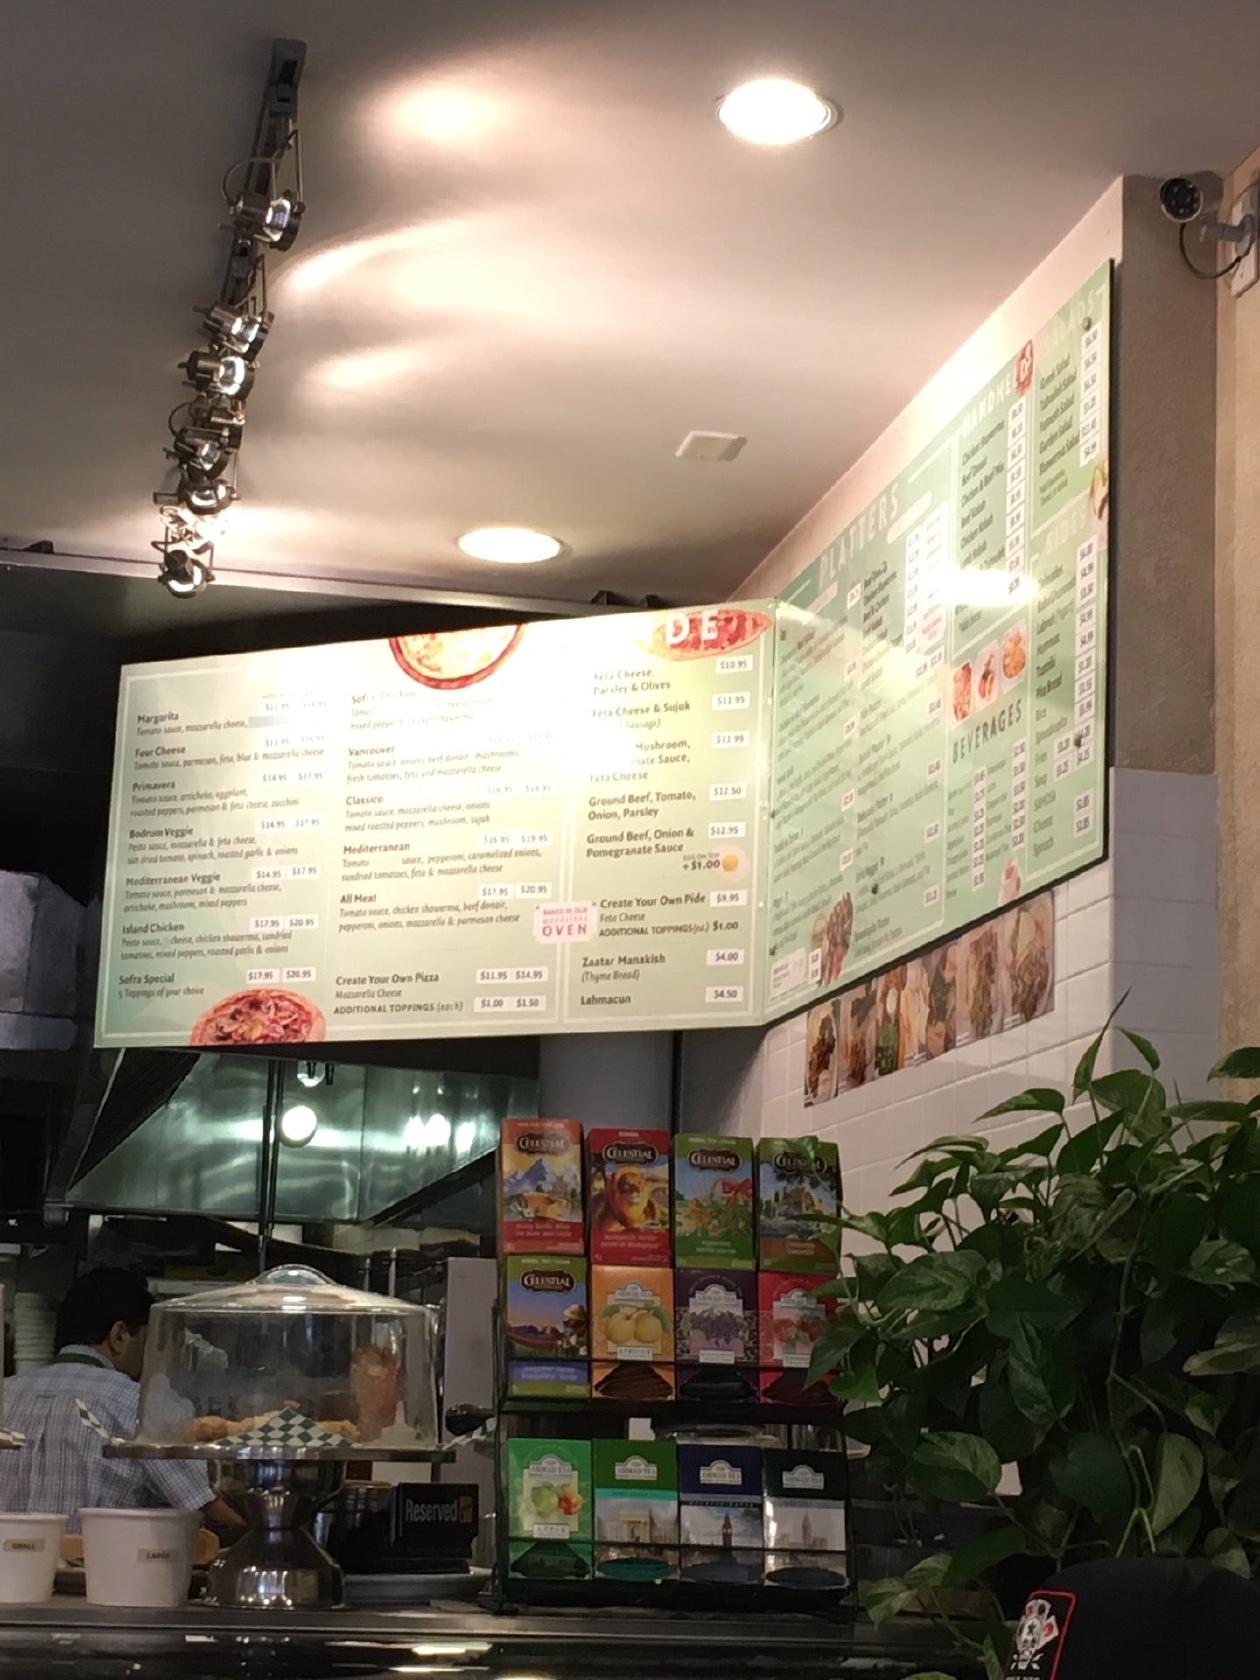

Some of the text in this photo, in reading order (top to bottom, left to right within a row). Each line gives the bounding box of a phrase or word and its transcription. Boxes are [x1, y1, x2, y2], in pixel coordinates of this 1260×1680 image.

[631, 680, 671, 692] & Olives
[653, 703, 660, 713] &
[663, 702, 690, 713] Sujuk
[136, 711, 179, 725] Margarita
[185, 721, 221, 732] mozzarella
[952, 696, 1021, 765] BEVERAGES
[135, 745, 186, 757] Four Cheese
[348, 744, 395, 756] Vancouver
[658, 754, 690, 765] Sauce,
[132, 780, 175, 791] Primavera
[345, 795, 383, 805] Classico
[588, 786, 741, 807] Ground Beef, Tomato, $12.50
[588, 807, 659, 822] Onion, Parsley
[128, 827, 193, 839] Bodrum Veggie
[587, 826, 739, 844] Ground Beef, Onion & $12.95
[343, 842, 410, 854] Mediterranean
[586, 843, 683, 859] Pomegranate Sauce
[437, 866, 477, 876] mozzarella
[126, 874, 188, 886] Mediterranean
[190, 872, 220, 884] Veggie
[340, 894, 352, 903] All
[354, 893, 376, 903] Meat
[599, 893, 739, 909] Create Your Own Pide $9.95
[406, 917, 445, 927] mozzarella
[495, 913, 520, 922] cheese
[599, 911, 645, 922] Feta Cheese
[122, 924, 148, 934] Island
[149, 922, 184, 932] Chicken
[254, 918, 279, 928] $17.95
[542, 925, 587, 937] OVEN
[598, 921, 739, 937] ADDITIONAL $1.00
[582, 952, 738, 967] Zaatar Manakish $4.00
[119, 968, 312, 985] Sofra Special $17.95 $20.95
[335, 970, 543, 986] Create Your Own Pizza $11.95 $14.95
[581, 971, 611, 982] (Thyme
[376, 988, 402, 997] Cheese
[580, 989, 737, 1005] Lahmacun $4.50
[333, 1004, 387, 1014] ADDITIONAL
[389, 1002, 434, 1012] TOPPINGS
[481, 999, 503, 1008] $1.00
[516, 999, 539, 1008] $1.50
[607, 1147, 653, 1160] CELESTIAL
[690, 1154, 735, 1167] CELESTIAL
[524, 1274, 570, 1288] CELESTIAL
[405, 1499, 458, 1522] Reserved
